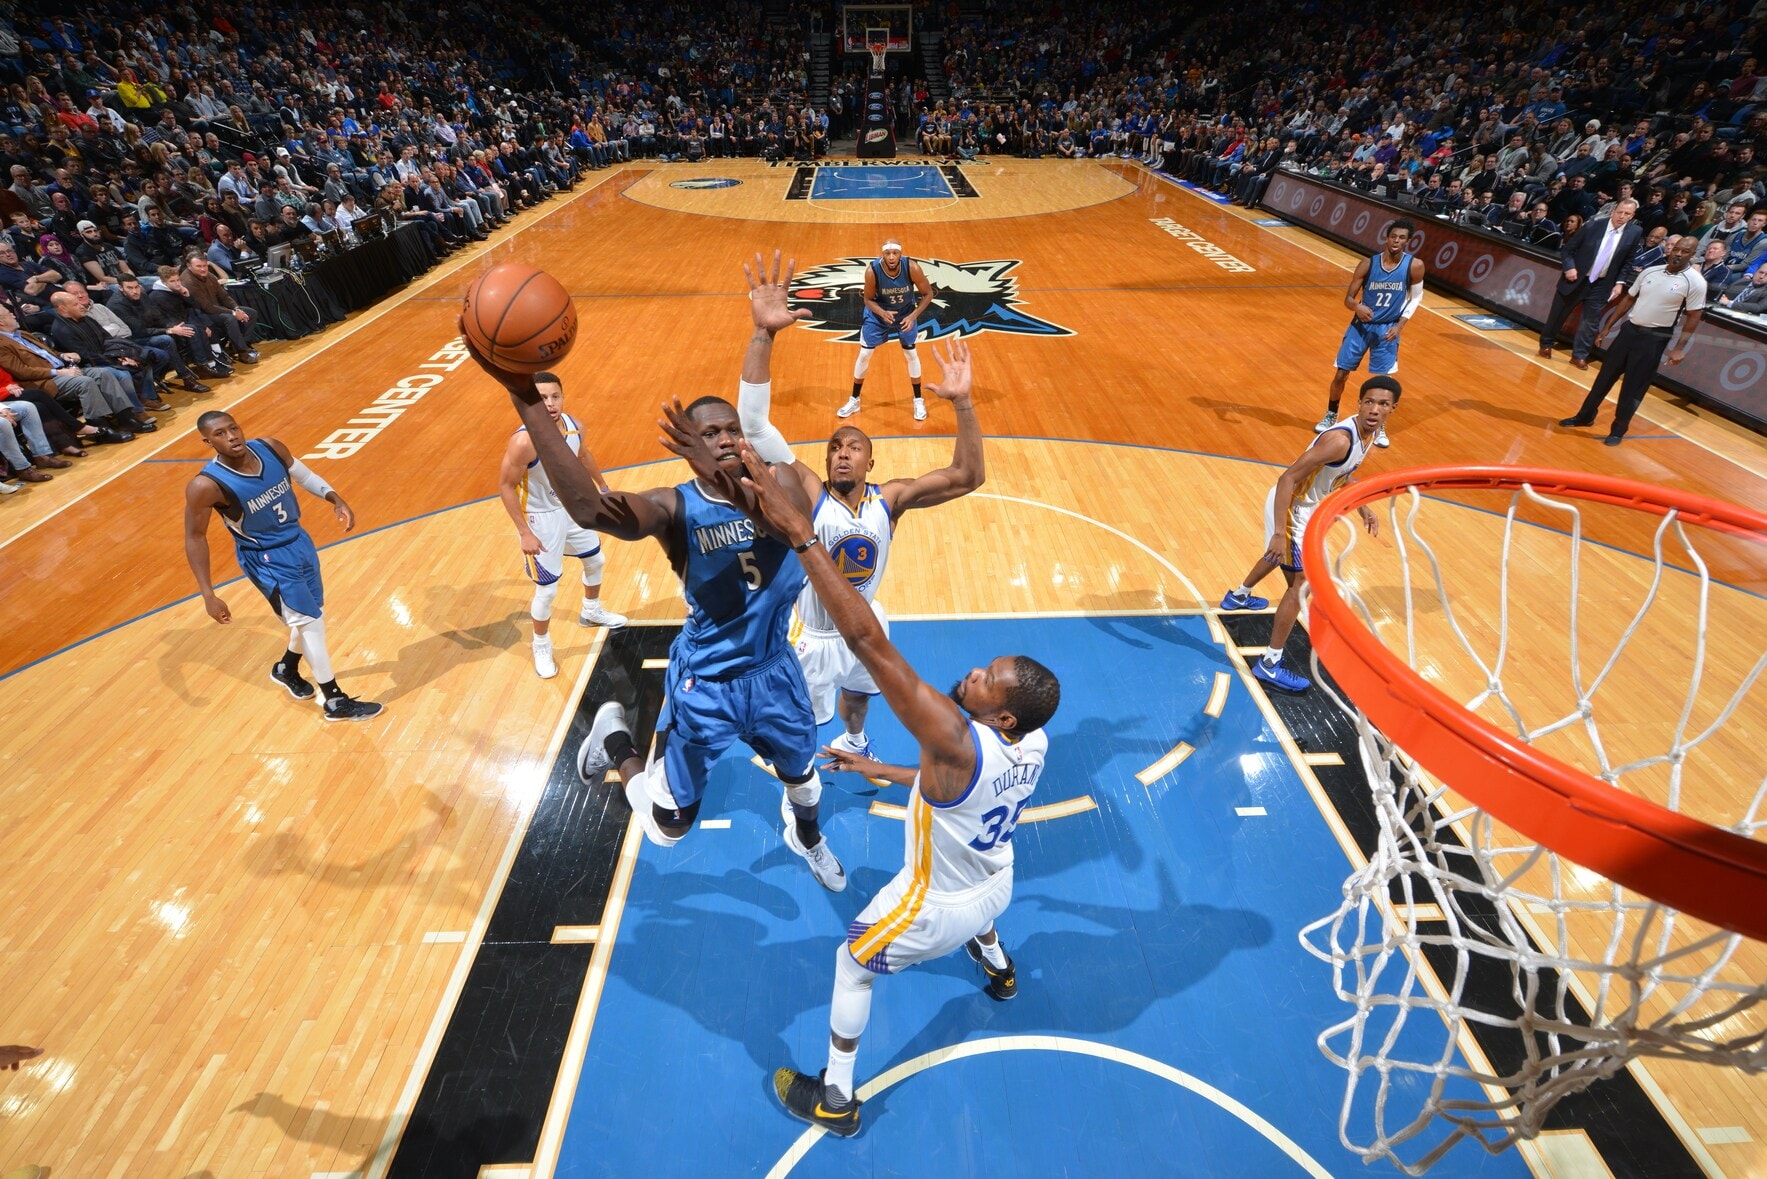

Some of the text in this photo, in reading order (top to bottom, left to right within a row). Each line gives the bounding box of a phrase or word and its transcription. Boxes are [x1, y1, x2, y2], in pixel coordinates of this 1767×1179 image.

[1148, 217, 1257, 273] TARGET CENTER
[881, 285, 910, 296] MINNESOTA
[1369, 281, 1403, 291] MINNESOTA
[889, 295, 904, 304] 33
[1375, 292, 1392, 307] 22
[300, 336, 471, 460] GET CENTER
[247, 477, 291, 514] MINNESOTA
[272, 502, 288, 524] 3
[695, 518, 769, 554] MINNES
[828, 528, 883, 547] GOLDEN STATE
[857, 546, 868, 561] 3
[737, 550, 762, 591] 5
[993, 763, 1040, 798] DURAN
